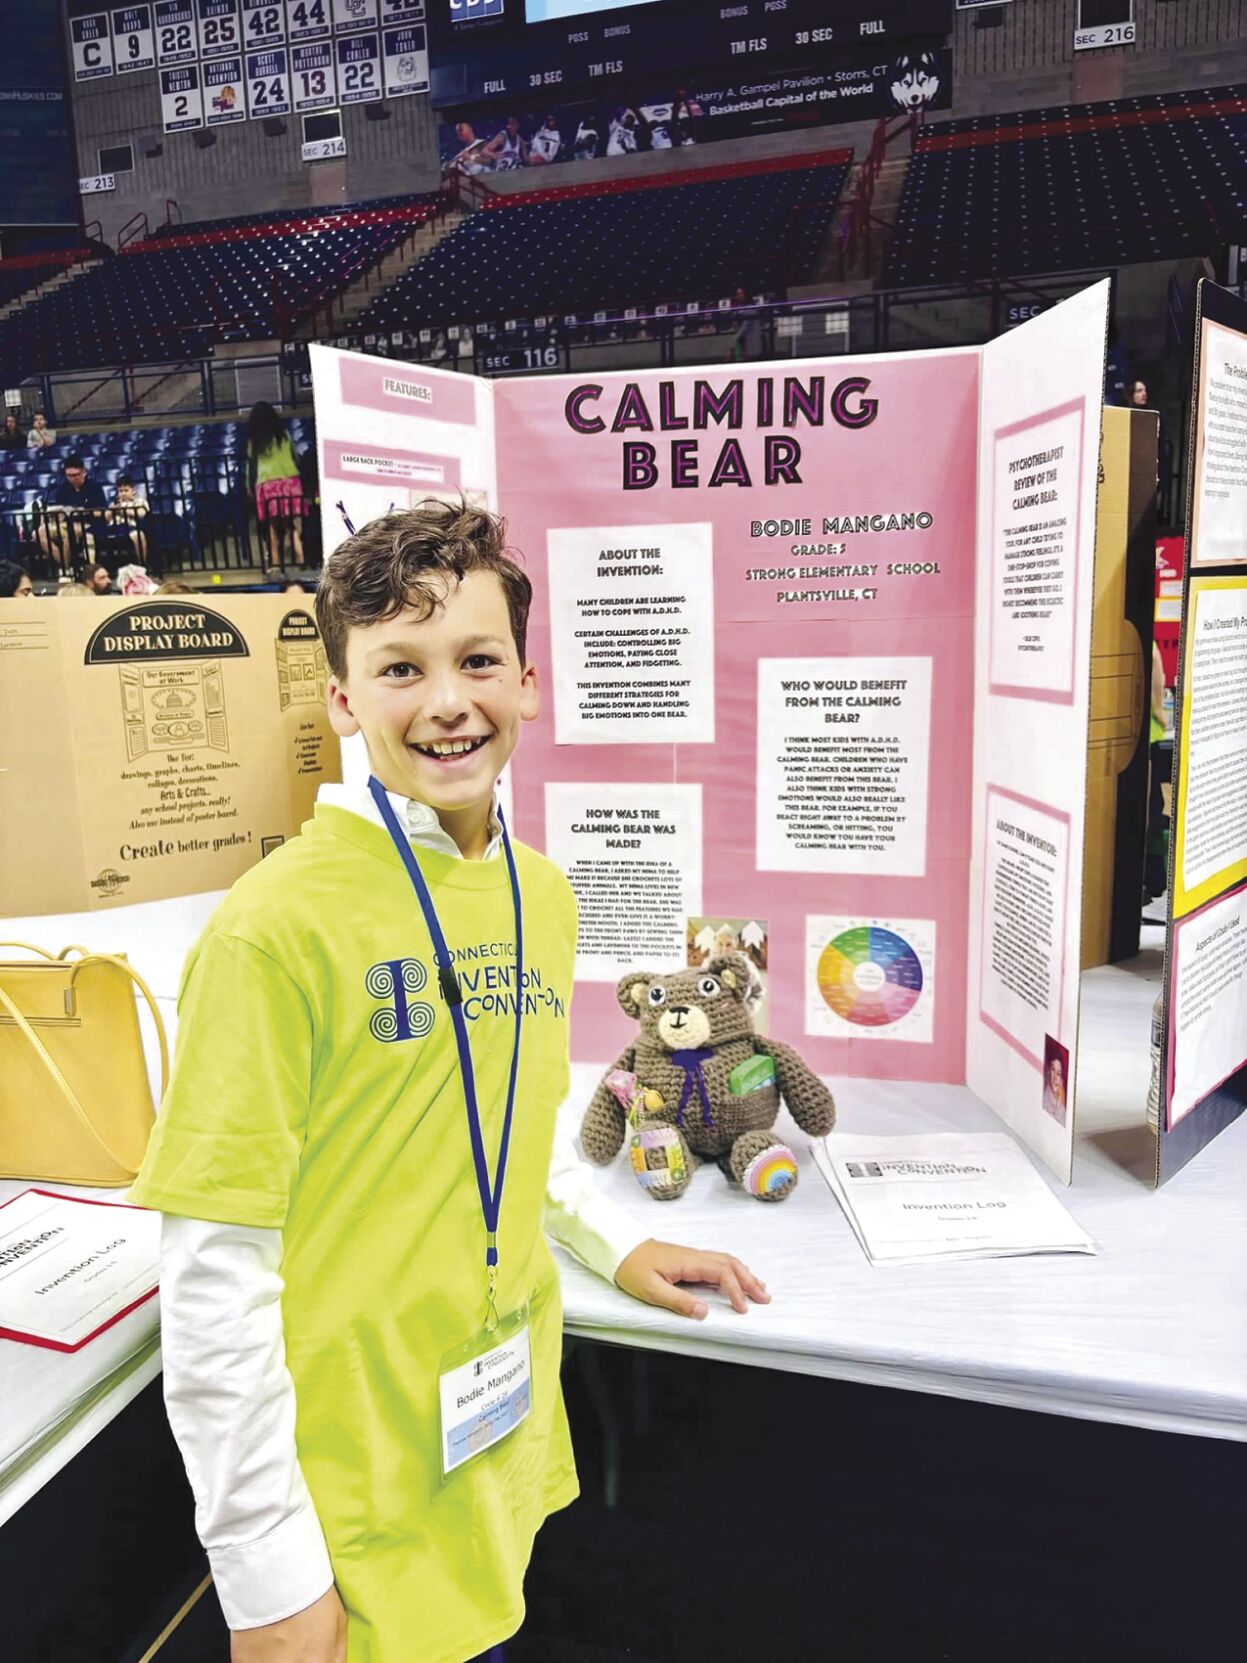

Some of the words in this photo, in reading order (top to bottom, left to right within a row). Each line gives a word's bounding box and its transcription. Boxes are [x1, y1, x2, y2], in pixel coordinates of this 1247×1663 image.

[293, 1, 325, 27] 44
[720, 6, 748, 19] BONUS
[765, 0, 787, 11] POSS
[204, 17, 234, 45] 25
[249, 9, 279, 35] 42
[162, 25, 191, 52] 22
[568, 32, 589, 43] POSS
[604, 25, 631, 38] BONUS
[731, 42, 746, 54] TM
[749, 38, 767, 50] FLS
[796, 32, 809, 44] 30
[812, 28, 832, 42] SEC
[860, 20, 885, 35] FULL
[1076, 34, 1096, 45] SEC
[1104, 26, 1133, 43] 216
[83, 42, 100, 66] C
[128, 35, 139, 58] 9
[301, 70, 325, 97] 13
[345, 62, 374, 90] 22
[484, 80, 506, 94] FULL
[530, 75, 541, 86] 30
[544, 71, 562, 84] SEC
[589, 64, 603, 77] TM
[606, 61, 622, 74] FLS
[696, 88, 725, 101] Harry
[727, 86, 736, 97] A.
[740, 81, 780, 96] Gampel
[783, 76, 823, 90] Pavilion
[873, 66, 887, 76] CT
[253, 78, 283, 105] 24
[710, 100, 764, 116] Basketball
[766, 95, 803, 108] Capital
[806, 92, 817, 101] of
[820, 89, 836, 99] the
[840, 83, 873, 97] World
[175, 96, 187, 116] 2
[304, 148, 317, 156] SEC
[323, 142, 344, 155] 214
[95, 177, 113, 189] 213
[1009, 306, 1040, 319] SEC
[487, 357, 509, 367] SEC
[524, 348, 557, 365] 116
[385, 380, 430, 400] FEATURES:
[565, 376, 879, 434] CALMING
[623, 435, 802, 490] BEAR
[1009, 446, 1064, 473] PSYCHOTHERAPIST
[1014, 474, 1036, 491] REVIEW
[1037, 472, 1045, 485] OF
[1047, 468, 1057, 483] THE
[1013, 494, 1039, 510] CALMING
[751, 519, 811, 537] BODIE
[822, 512, 933, 534] MANGANO
[599, 550, 638, 560] ABOUT
[640, 548, 660, 558] THE
[791, 544, 837, 556] GRADE:
[597, 565, 663, 577] INVENTION:
[746, 567, 796, 580] STRONG
[800, 565, 878, 578] ELEMENTARY
[887, 562, 940, 575] SCHOOL
[650, 596, 686, 604] LEARNING
[777, 589, 858, 603] PLANTSVILLE,
[862, 588, 877, 600] CT
[129, 615, 205, 631] PROJECT
[104, 635, 174, 652] DISPLAY
[178, 632, 233, 648] BOARD
[147, 671, 157, 679] Our
[781, 681, 810, 691] WHO
[813, 681, 857, 690] WOULD
[861, 680, 907, 690] BENEFIT
[785, 697, 819, 707] FROM
[822, 697, 843, 707] THE
[846, 697, 901, 707] CALMING
[825, 713, 860, 723] BEAR?
[182, 753, 194, 761] for:
[161, 790, 175, 800] Arts
[177, 789, 183, 800] &
[586, 810, 613, 819] HOW
[616, 810, 638, 819] WAS
[640, 810, 660, 819] THE
[571, 824, 620, 833] CALMING
[624, 825, 651, 833] BEAR
[653, 825, 676, 834] WAS
[120, 840, 174, 860] Create
[178, 839, 210, 853] better
[606, 840, 642, 848] MADE?
[433, 943, 517, 966] CONNECTIC
[35, 1254, 99, 1295] Invention
[96, 1238, 126, 1254] Log
[457, 1387, 484, 1408] Bodie
[488, 1360, 525, 1391] Mangano
